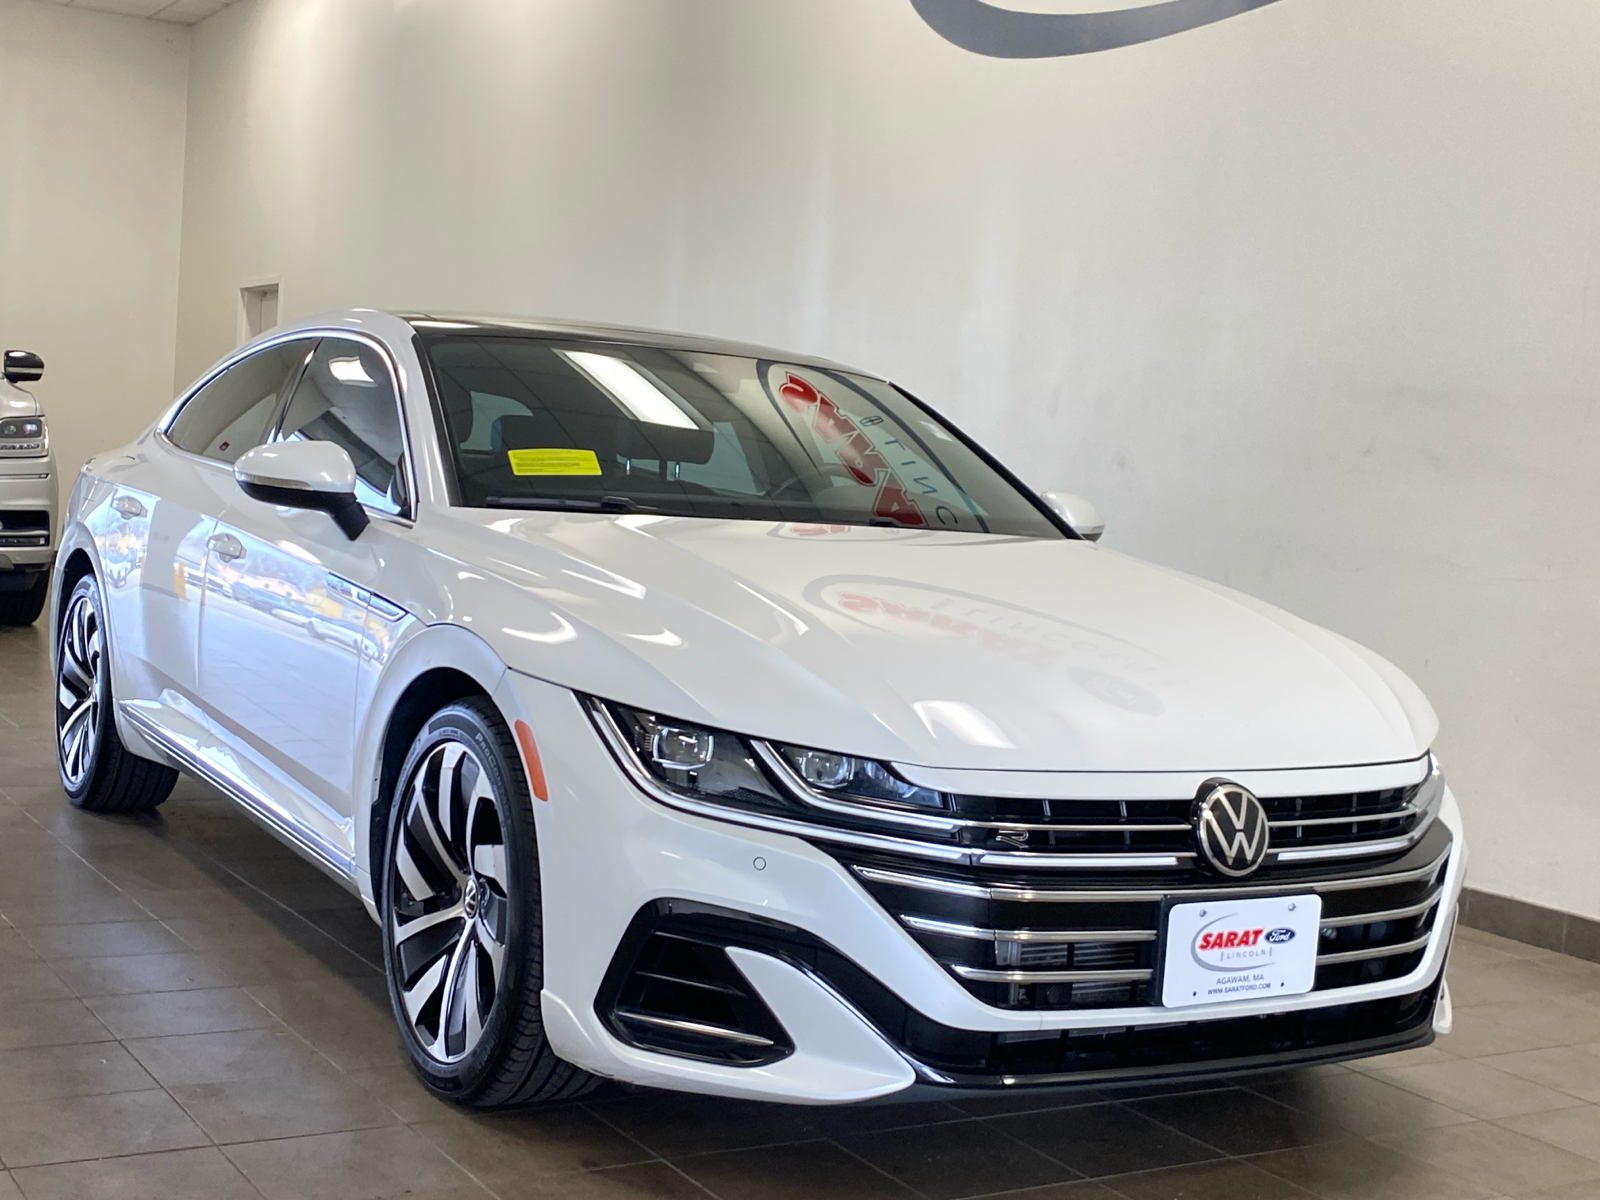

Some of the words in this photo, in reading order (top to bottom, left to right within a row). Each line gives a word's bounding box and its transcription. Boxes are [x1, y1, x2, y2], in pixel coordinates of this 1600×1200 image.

[1198, 927, 1265, 950] SARAT
[1267, 929, 1292, 943] Ford
[1227, 950, 1266, 960] LINCOLN
[1215, 975, 1251, 985] AGAWAM,
[1207, 983, 1271, 995] WWW.SARATFORD.COM
